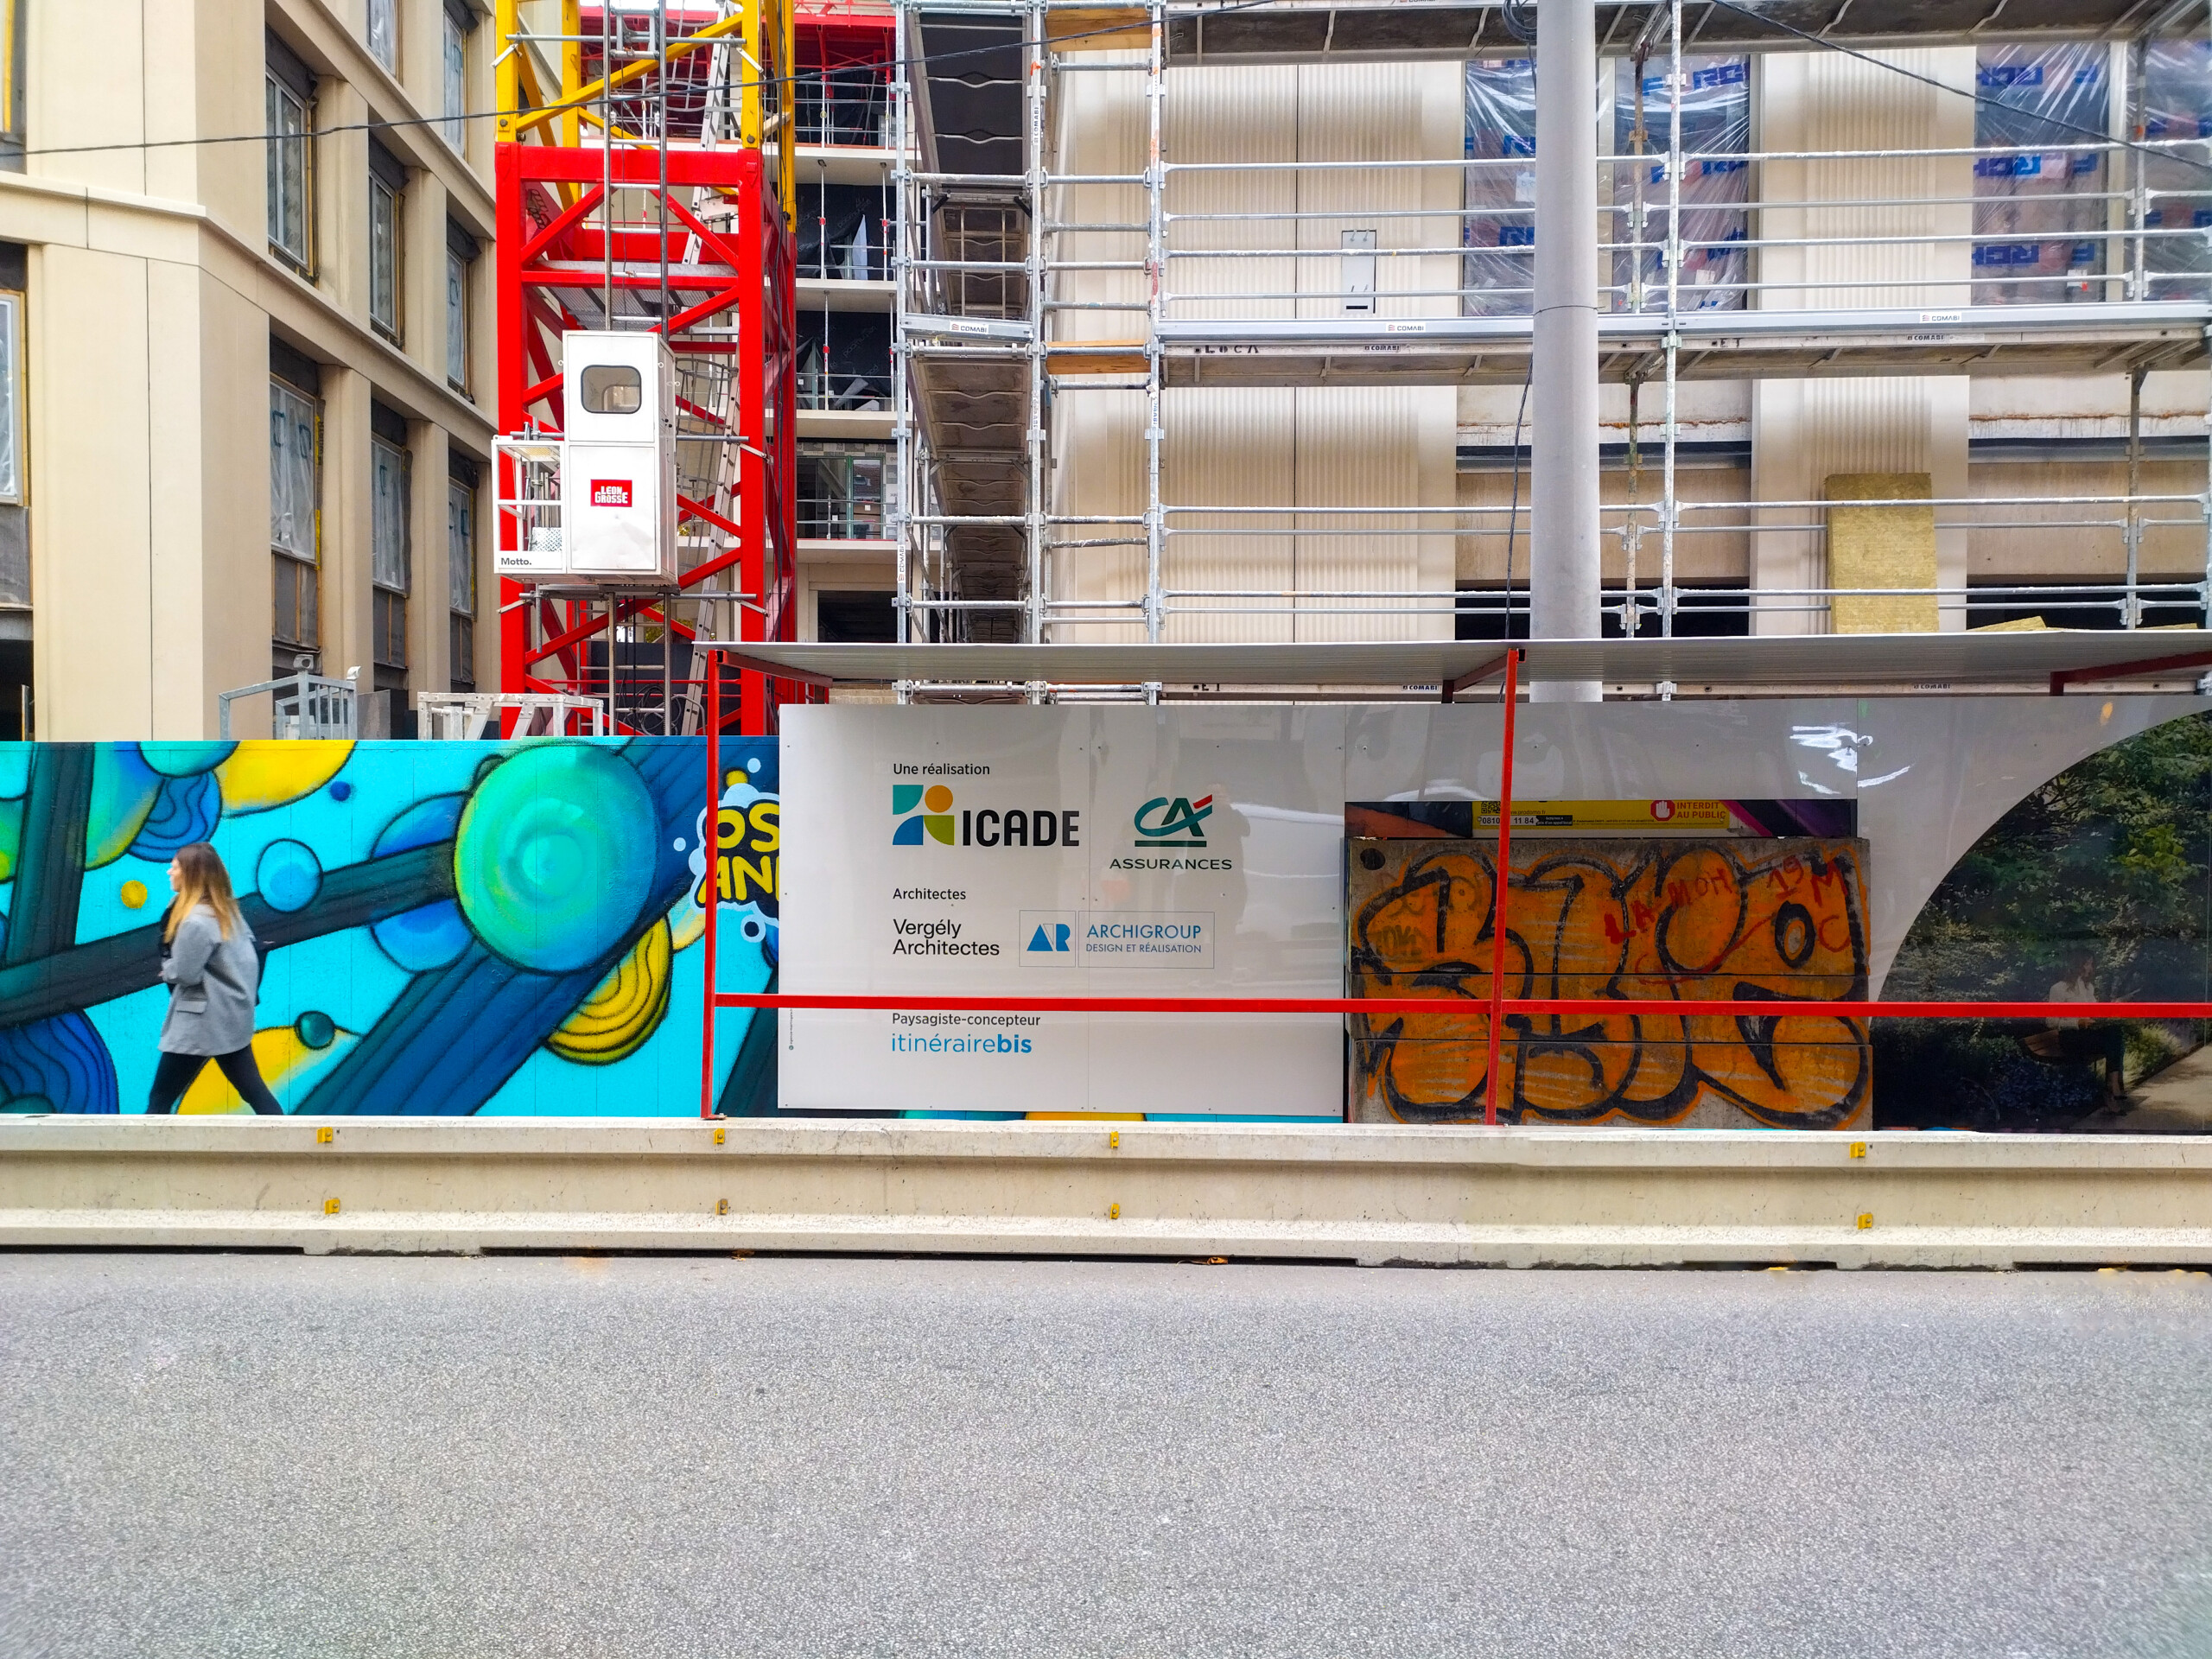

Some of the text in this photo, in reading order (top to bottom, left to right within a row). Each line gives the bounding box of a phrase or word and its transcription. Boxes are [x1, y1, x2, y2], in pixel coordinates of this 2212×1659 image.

[960, 325, 988, 334] COMABI
[601, 486, 623, 496] LEON
[594, 492, 629, 505] GROSSE
[500, 557, 532, 566] Motto.
[893, 763, 990, 775] Une réalisation
[1692, 810, 1726, 820] PUBLIC
[963, 810, 1080, 847] ICADE
[1109, 858, 1233, 870] ASSURANCES
[696, 855, 780, 905] AN
[893, 888, 966, 900] Architectes
[893, 918, 962, 939] Vergély
[1086, 924, 1202, 939] ARCHIGROUP
[893, 939, 1000, 956] Architectes
[1085, 944, 1123, 952] DESIGN
[1139, 942, 1202, 953] RÉALISATION
[892, 1013, 1041, 1027] Paysagiste-concepteur
[892, 1033, 1033, 1053] itinérairebis
